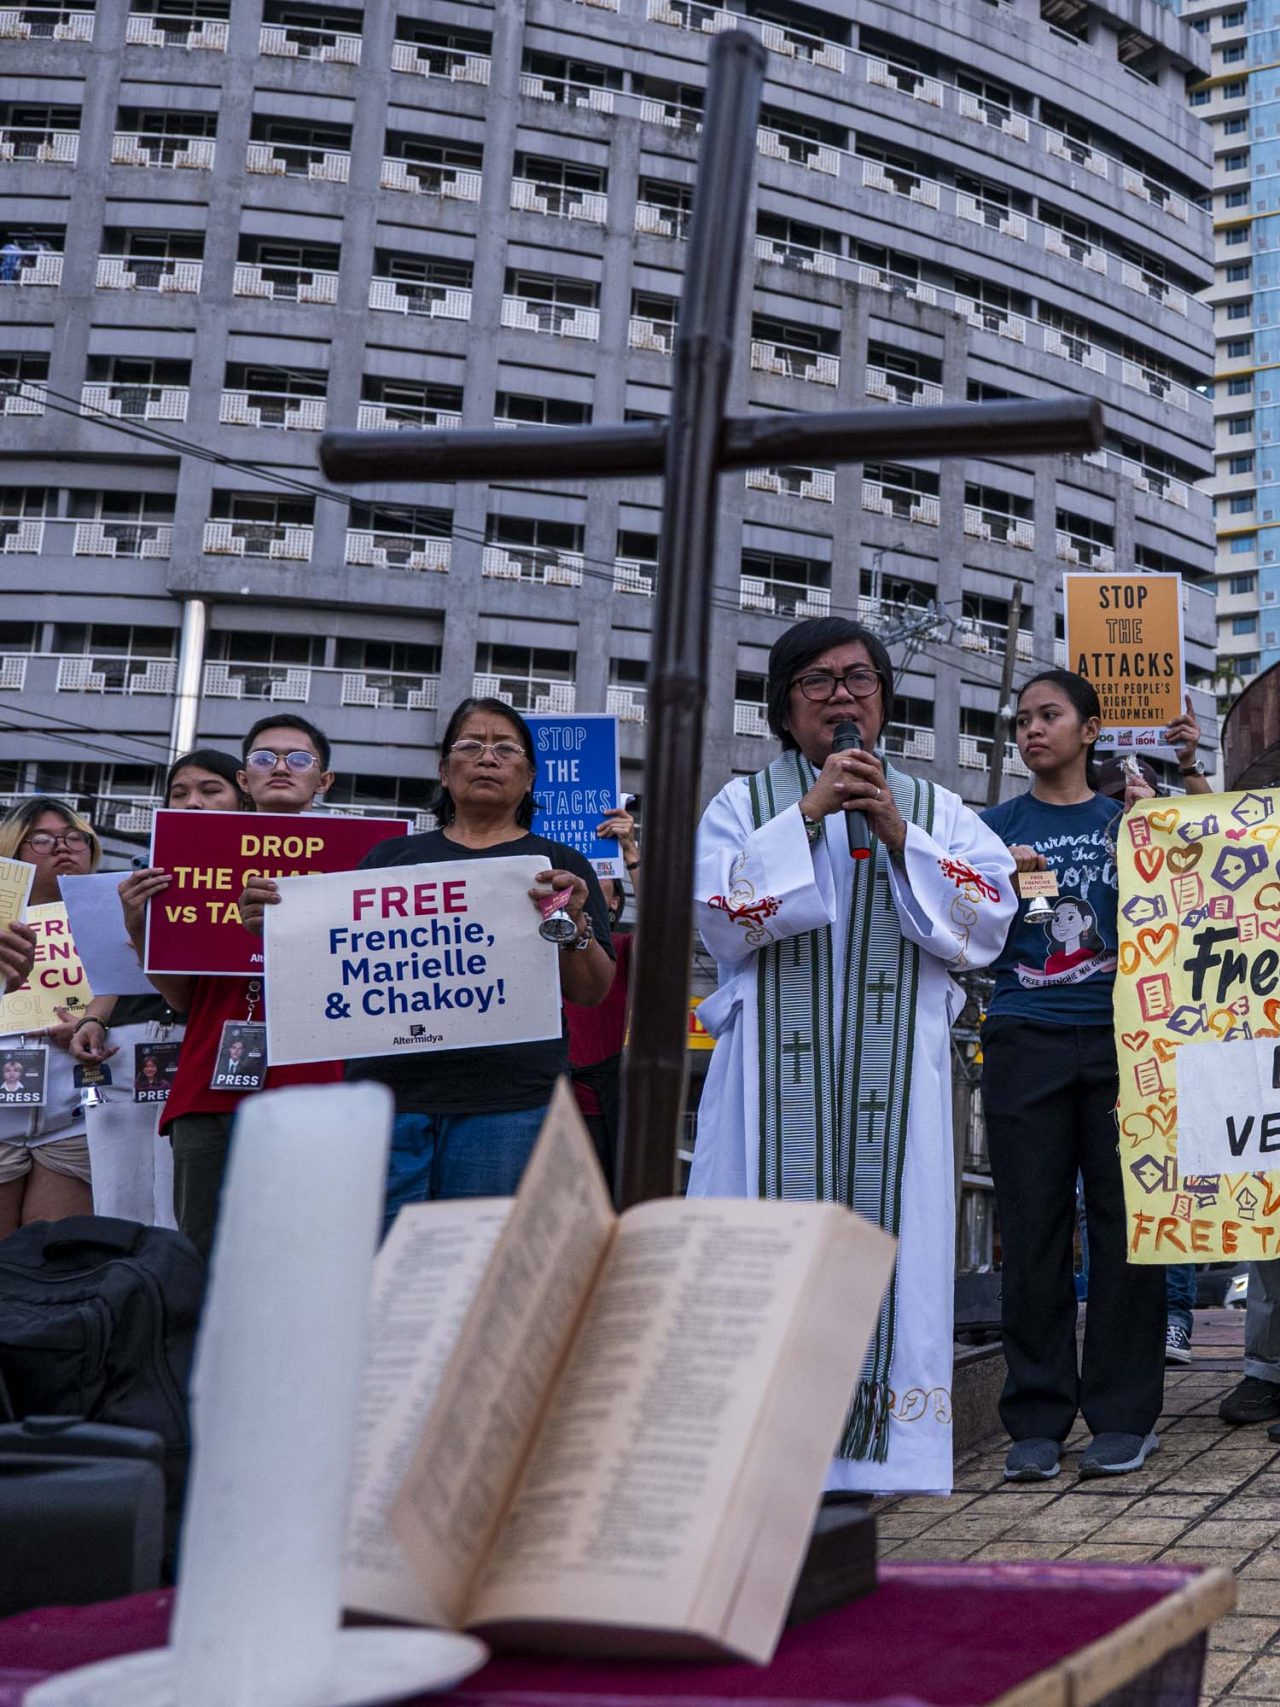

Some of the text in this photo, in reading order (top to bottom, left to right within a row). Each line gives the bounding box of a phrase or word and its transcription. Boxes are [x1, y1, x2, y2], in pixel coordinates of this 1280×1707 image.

[1099, 585, 1148, 609] STOP
[1106, 618, 1143, 644] THE
[1078, 652, 1174, 678] ATTACKS
[1124, 682, 1170, 695] PEOPLE'S
[1104, 696, 1150, 707] RIGHT TO
[1101, 708, 1164, 720] VELOPMENT!
[537, 726, 587, 751] STOP
[1135, 737, 1155, 746] IBON
[545, 759, 580, 783] THE
[533, 789, 611, 816] TTACKS
[543, 819, 584, 831] DEFEND
[241, 834, 325, 858] DROP
[173, 866, 233, 890] THE
[353, 880, 468, 921] FREE
[165, 905, 198, 924] vs
[329, 916, 495, 955] Frenchie,
[341, 948, 487, 986] Marielle
[324, 978, 506, 1020] & Chakoy!
[393, 1033, 444, 1046] Altermidya
[216, 1074, 259, 1086] PRESS
[0, 1092, 41, 1102] PRESS
[138, 1089, 171, 1101] PRES
[1130, 1209, 1243, 1254] FREE
